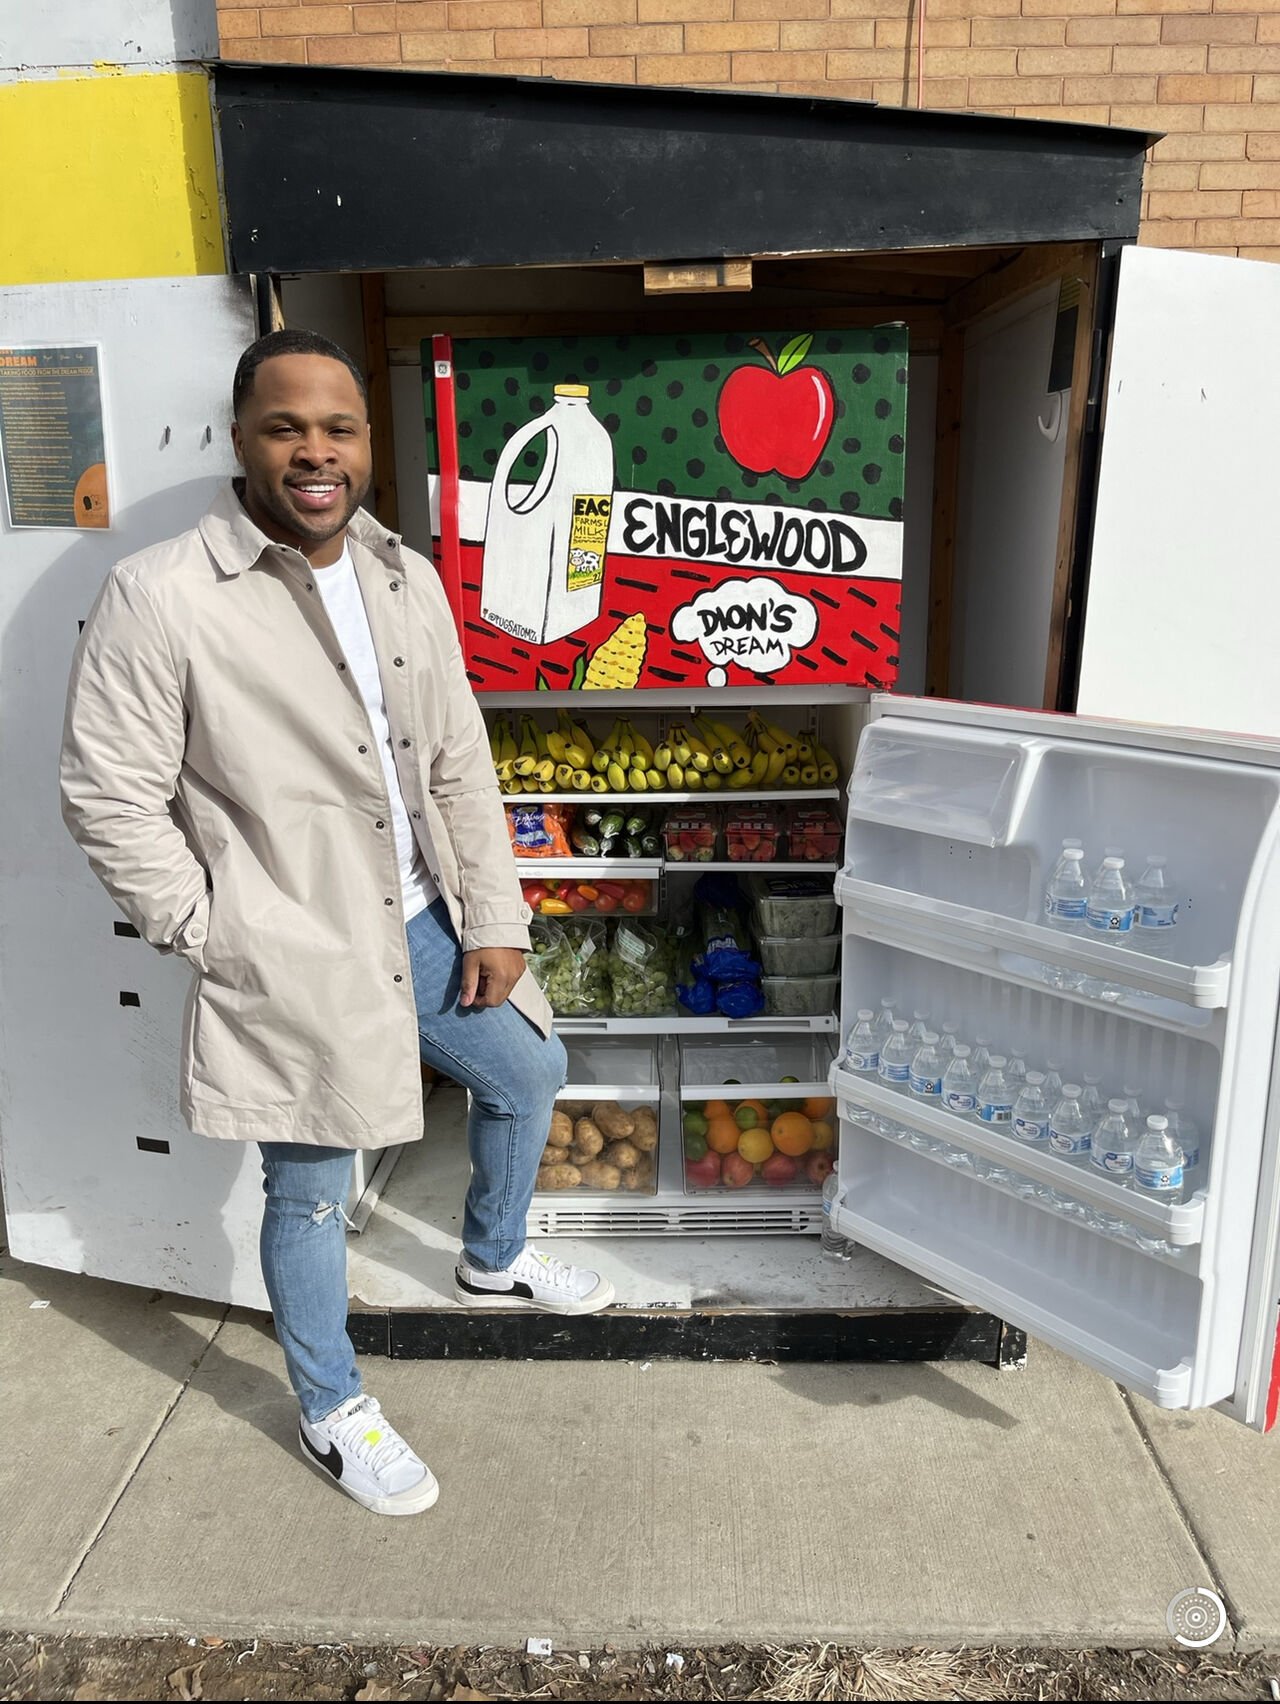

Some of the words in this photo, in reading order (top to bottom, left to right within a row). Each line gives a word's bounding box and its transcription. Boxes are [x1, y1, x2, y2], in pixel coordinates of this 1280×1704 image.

[0, 356, 37, 367] DREAM
[574, 498, 610, 517] EAC
[573, 525, 604, 537] MILK
[575, 516, 602, 527] FARMS
[623, 498, 868, 572] ENGLEWOOD
[697, 598, 796, 637] DION'S
[710, 637, 784, 656] DREAM
